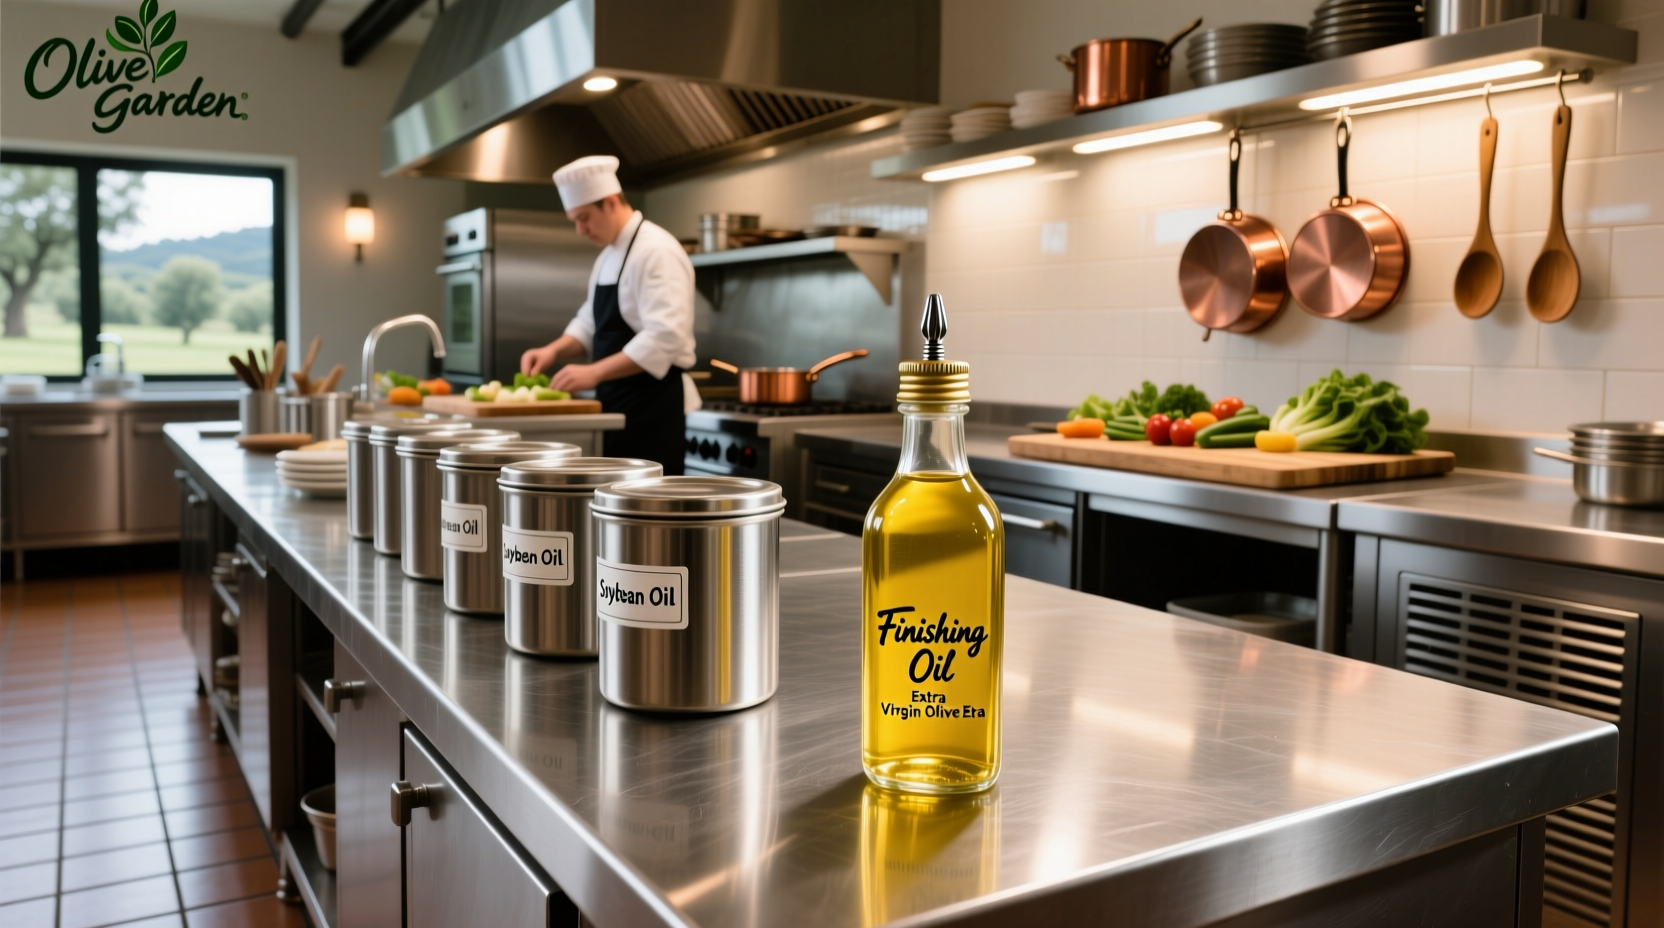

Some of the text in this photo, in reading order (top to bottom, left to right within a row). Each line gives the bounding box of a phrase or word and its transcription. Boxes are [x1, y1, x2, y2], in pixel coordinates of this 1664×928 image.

[462, 519, 478, 535] Oil
[541, 548, 564, 566] Oil
[649, 586, 675, 606] Oil
[877, 606, 988, 658] Finishing
[908, 648, 956, 683] Oil
[911, 690, 946, 704] Extra
[925, 704, 960, 718] Olive
